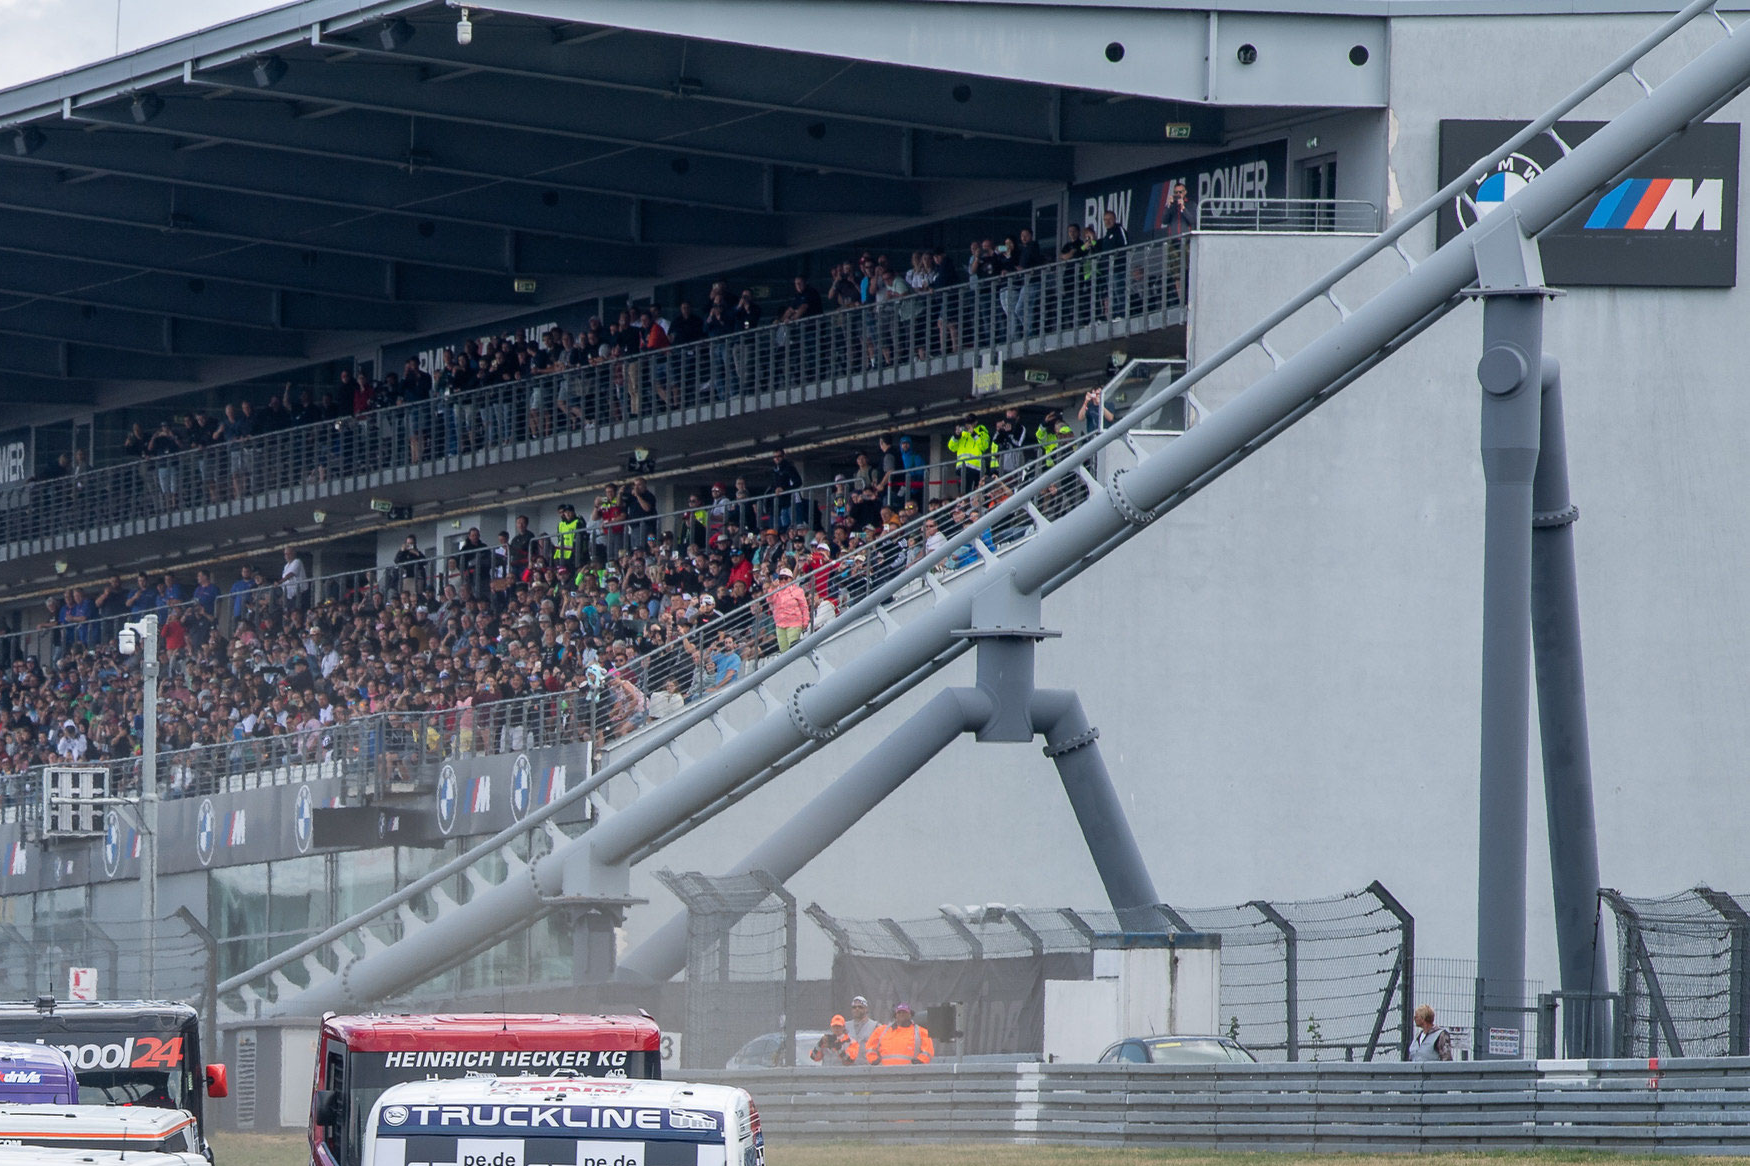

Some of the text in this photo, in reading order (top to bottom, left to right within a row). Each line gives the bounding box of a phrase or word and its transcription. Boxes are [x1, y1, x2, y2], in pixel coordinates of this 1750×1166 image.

[1198, 160, 1269, 217] POWER
[385, 1051, 627, 1069] HEINRICH HECKER KG
[407, 1105, 662, 1129] TRUCKLINE
